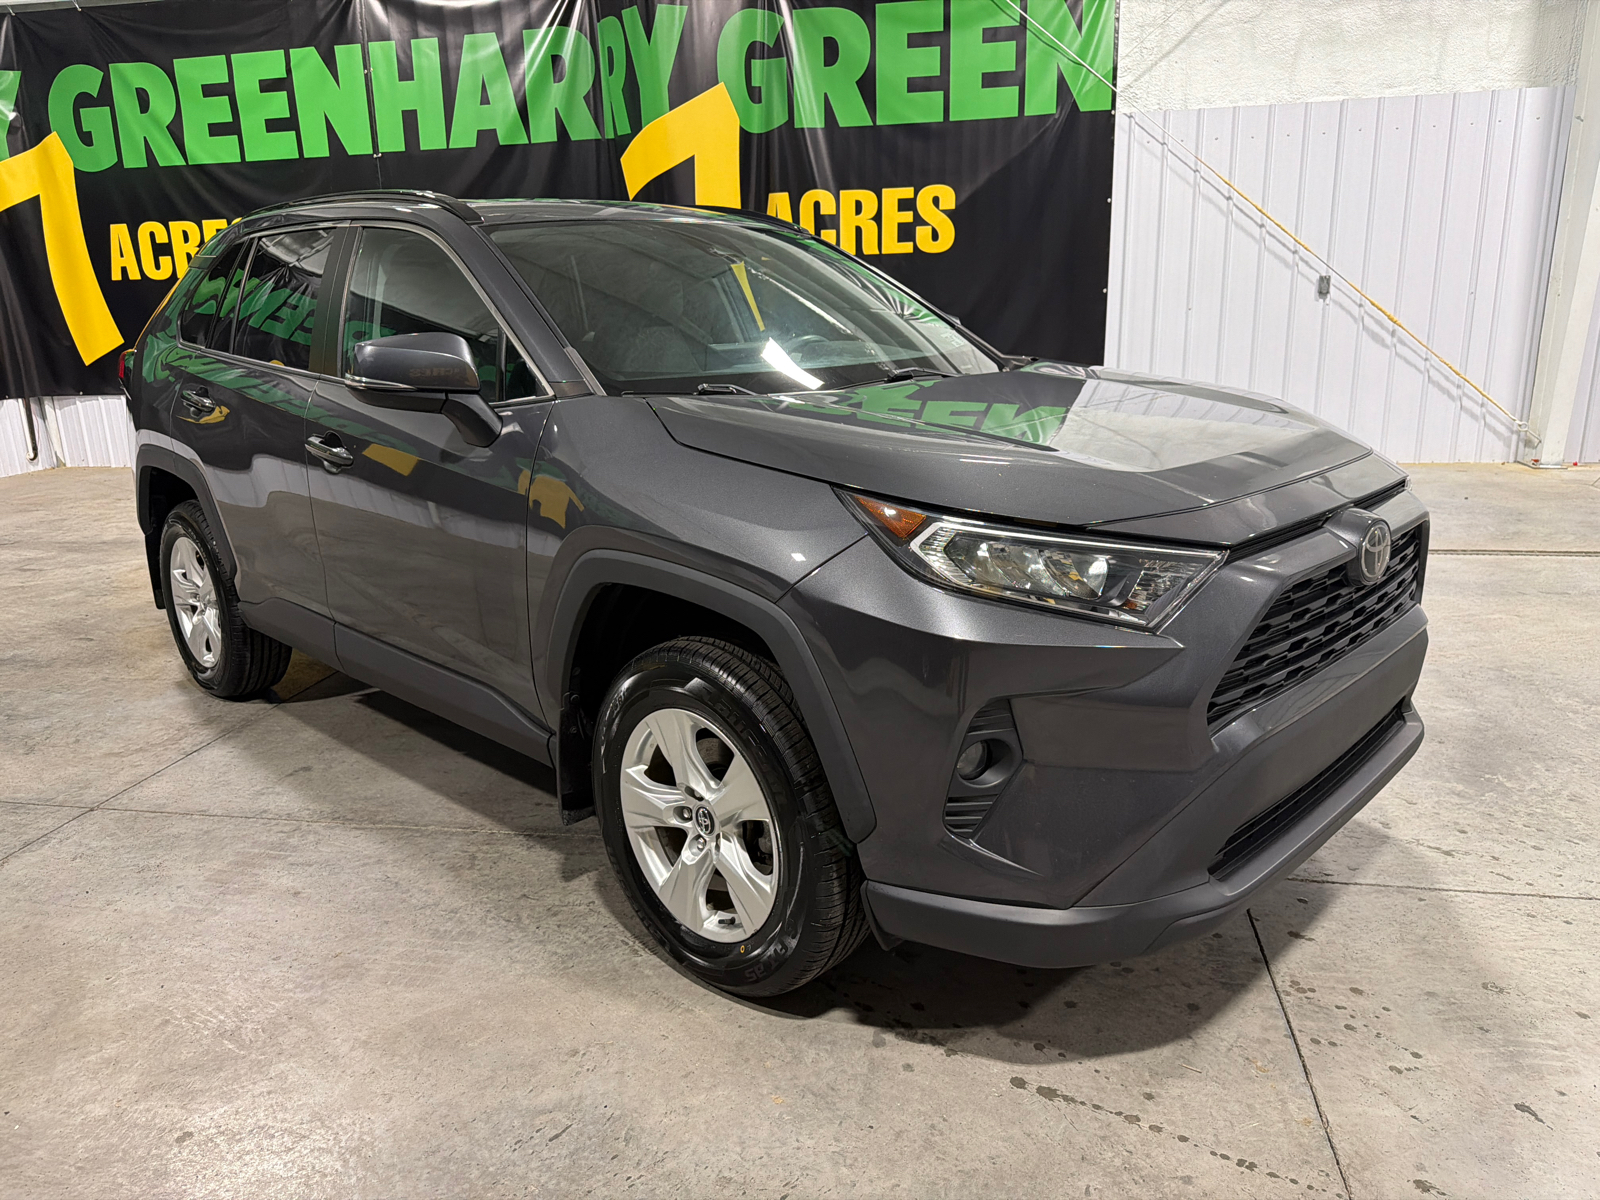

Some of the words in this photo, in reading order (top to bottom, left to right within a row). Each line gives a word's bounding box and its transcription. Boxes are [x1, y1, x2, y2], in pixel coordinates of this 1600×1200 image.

[717, 0, 1113, 134] GREEN
[0, 131, 124, 366] 7
[110, 217, 242, 281] ACR
